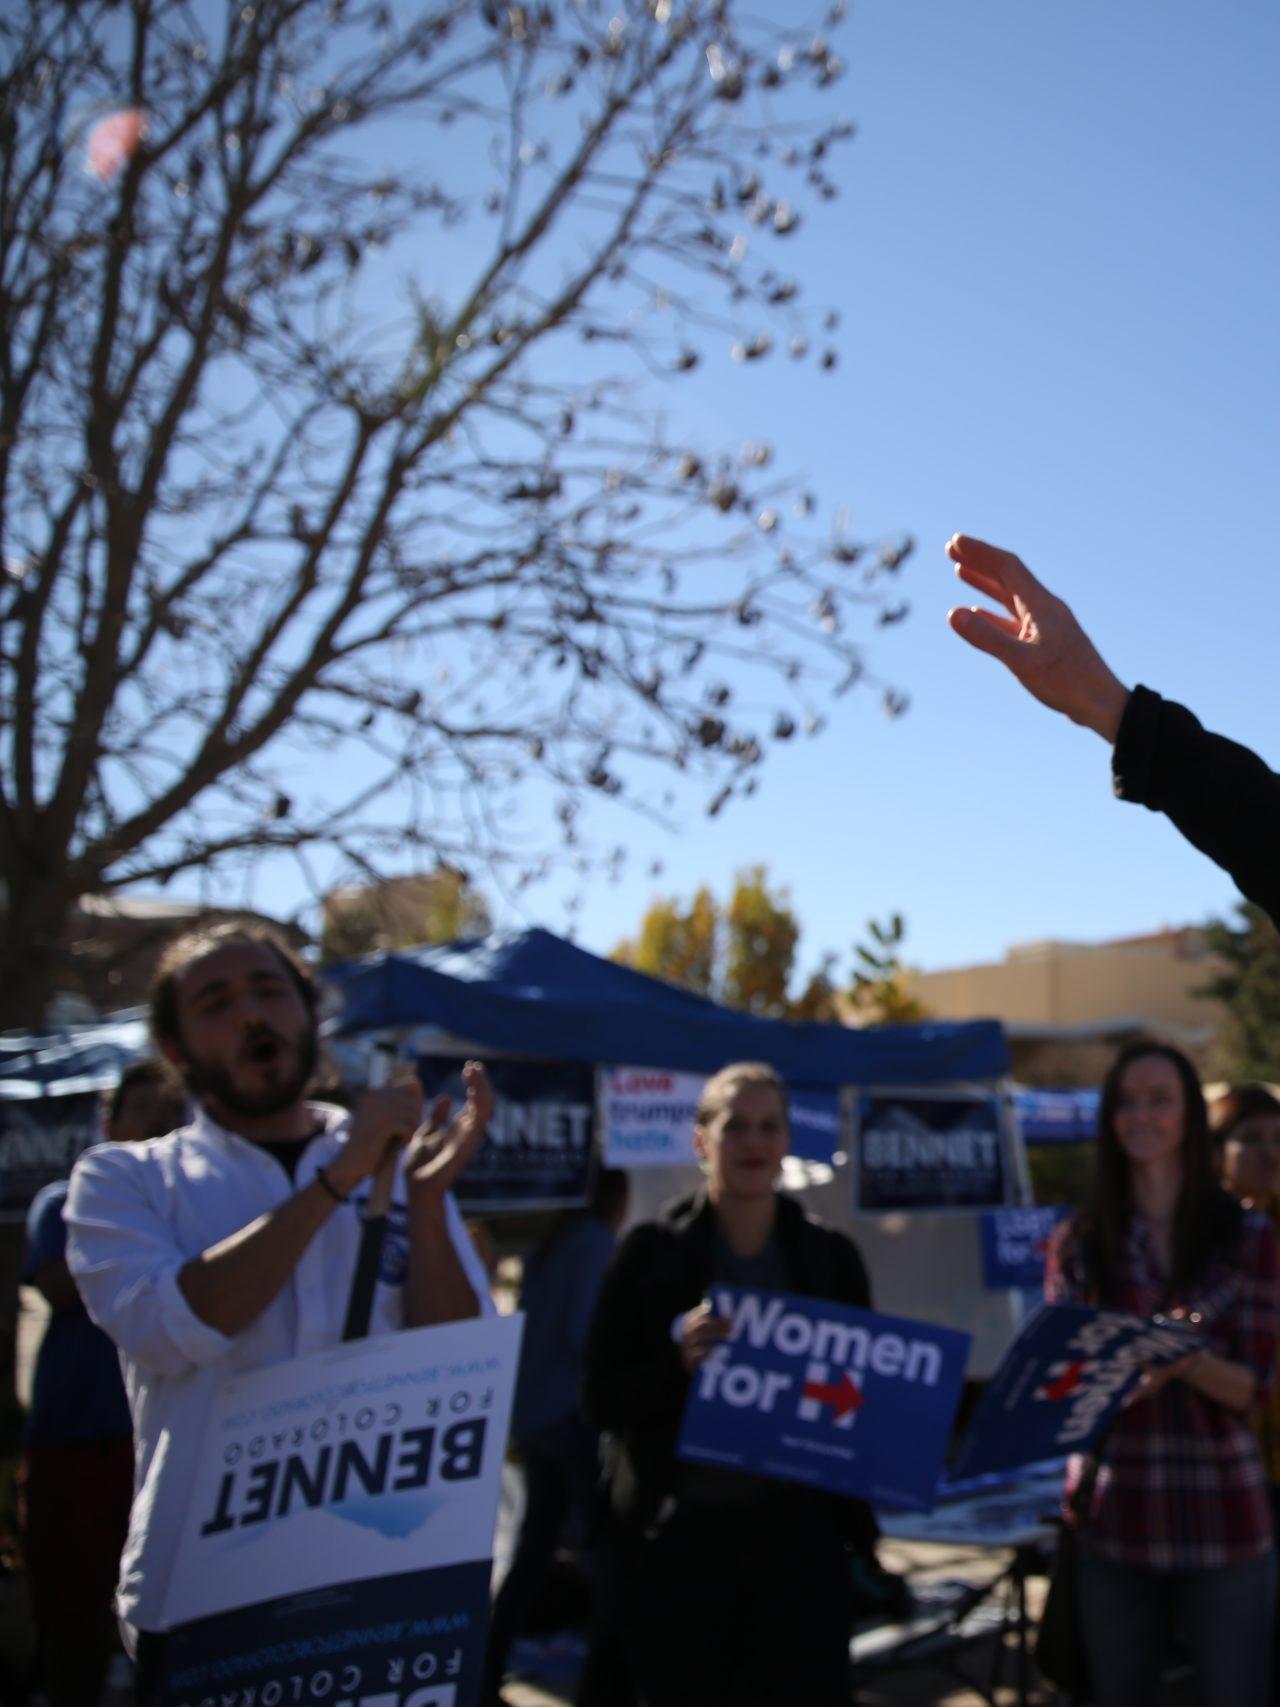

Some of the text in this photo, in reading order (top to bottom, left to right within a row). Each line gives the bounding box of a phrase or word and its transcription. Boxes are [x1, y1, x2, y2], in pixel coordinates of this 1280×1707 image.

[863, 1129, 997, 1169] BENNET
[716, 1292, 942, 1387] Women
[699, 1345, 792, 1412] for
[223, 1386, 495, 1466] FOR COLORADO
[201, 1417, 487, 1537] BENNET
[386, 1648, 462, 1685] FOR
